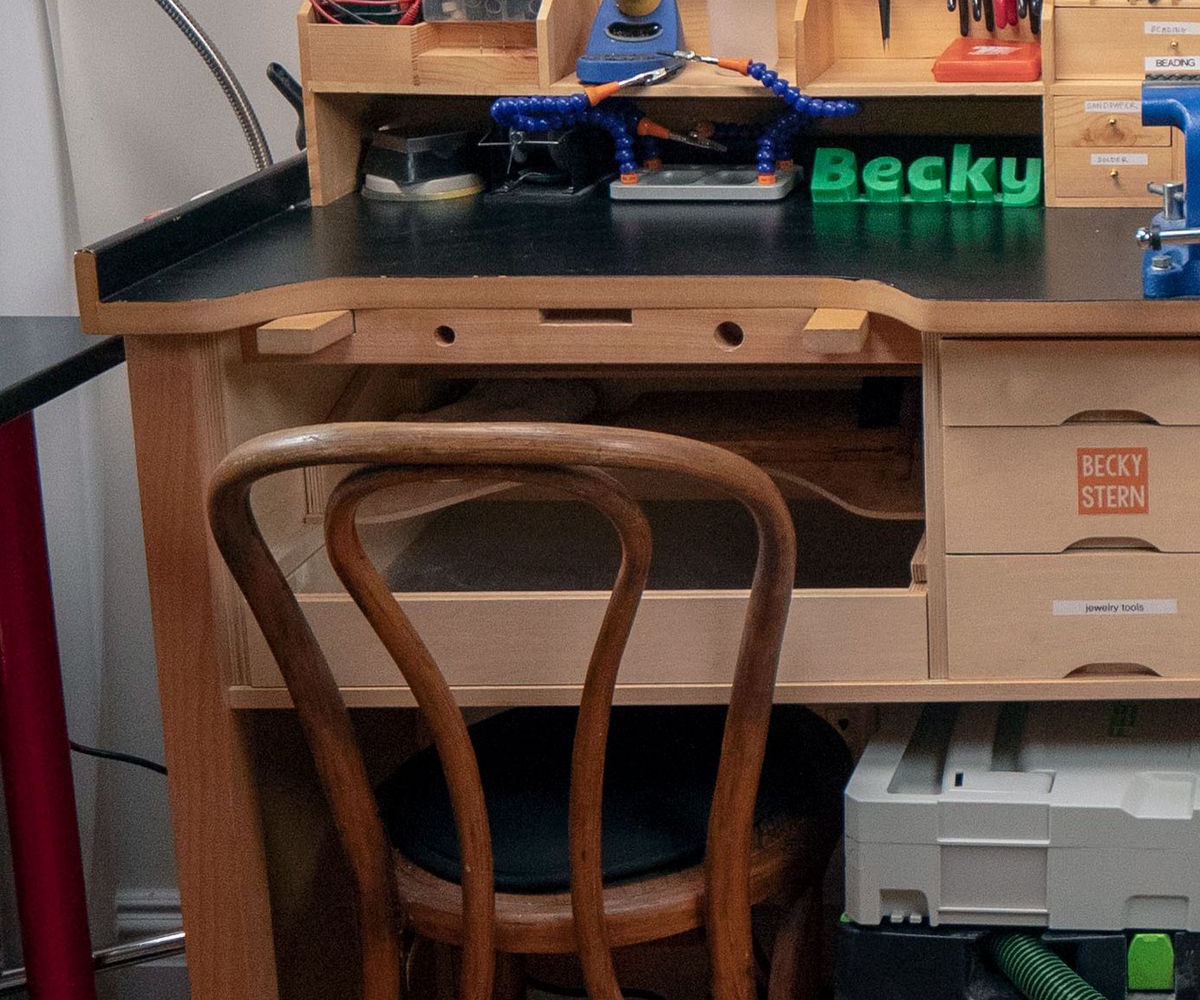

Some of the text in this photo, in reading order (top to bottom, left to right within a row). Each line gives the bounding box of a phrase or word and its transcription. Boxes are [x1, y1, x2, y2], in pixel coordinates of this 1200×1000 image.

[1155, 58, 1196, 68] BEADING
[810, 143, 1042, 208] Becky
[1082, 453, 1143, 478] BECKY
[1081, 485, 1145, 509] STERN
[1085, 601, 1145, 613] jewelry tools
